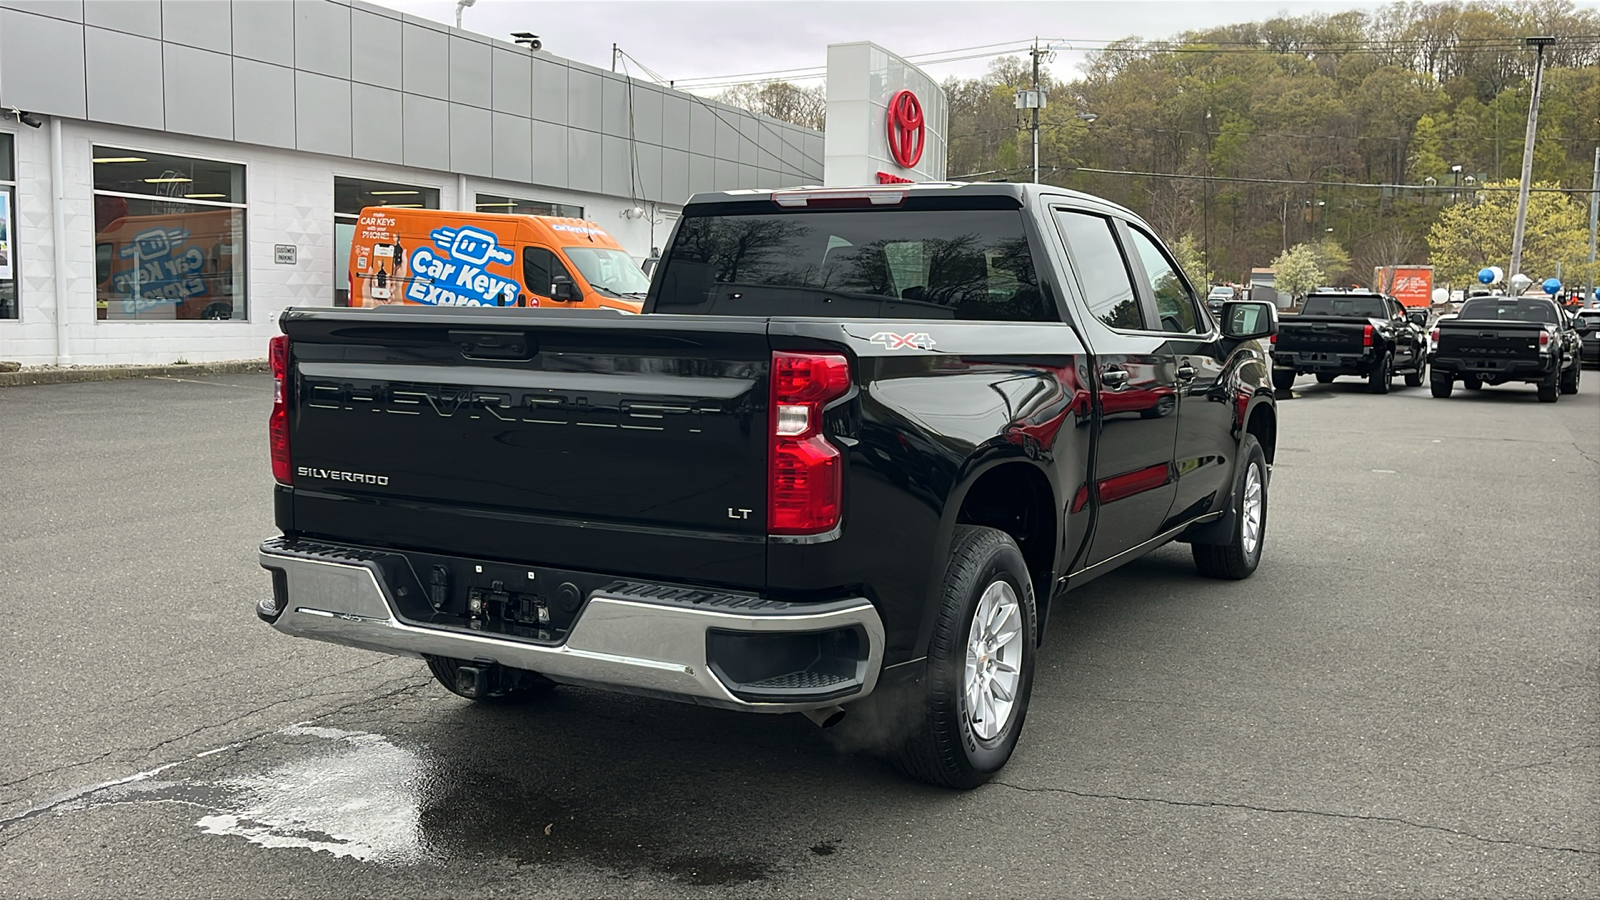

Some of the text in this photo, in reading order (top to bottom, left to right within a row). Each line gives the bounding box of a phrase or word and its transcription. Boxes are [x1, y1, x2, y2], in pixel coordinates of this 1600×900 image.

[360, 216, 396, 227] CAR KEYS
[412, 250, 518, 302] Car Keys
[408, 276, 493, 306] Expr
[307, 382, 721, 432] CHEVROLET
[297, 466, 389, 486] SILVERADO
[727, 507, 753, 520] LT
